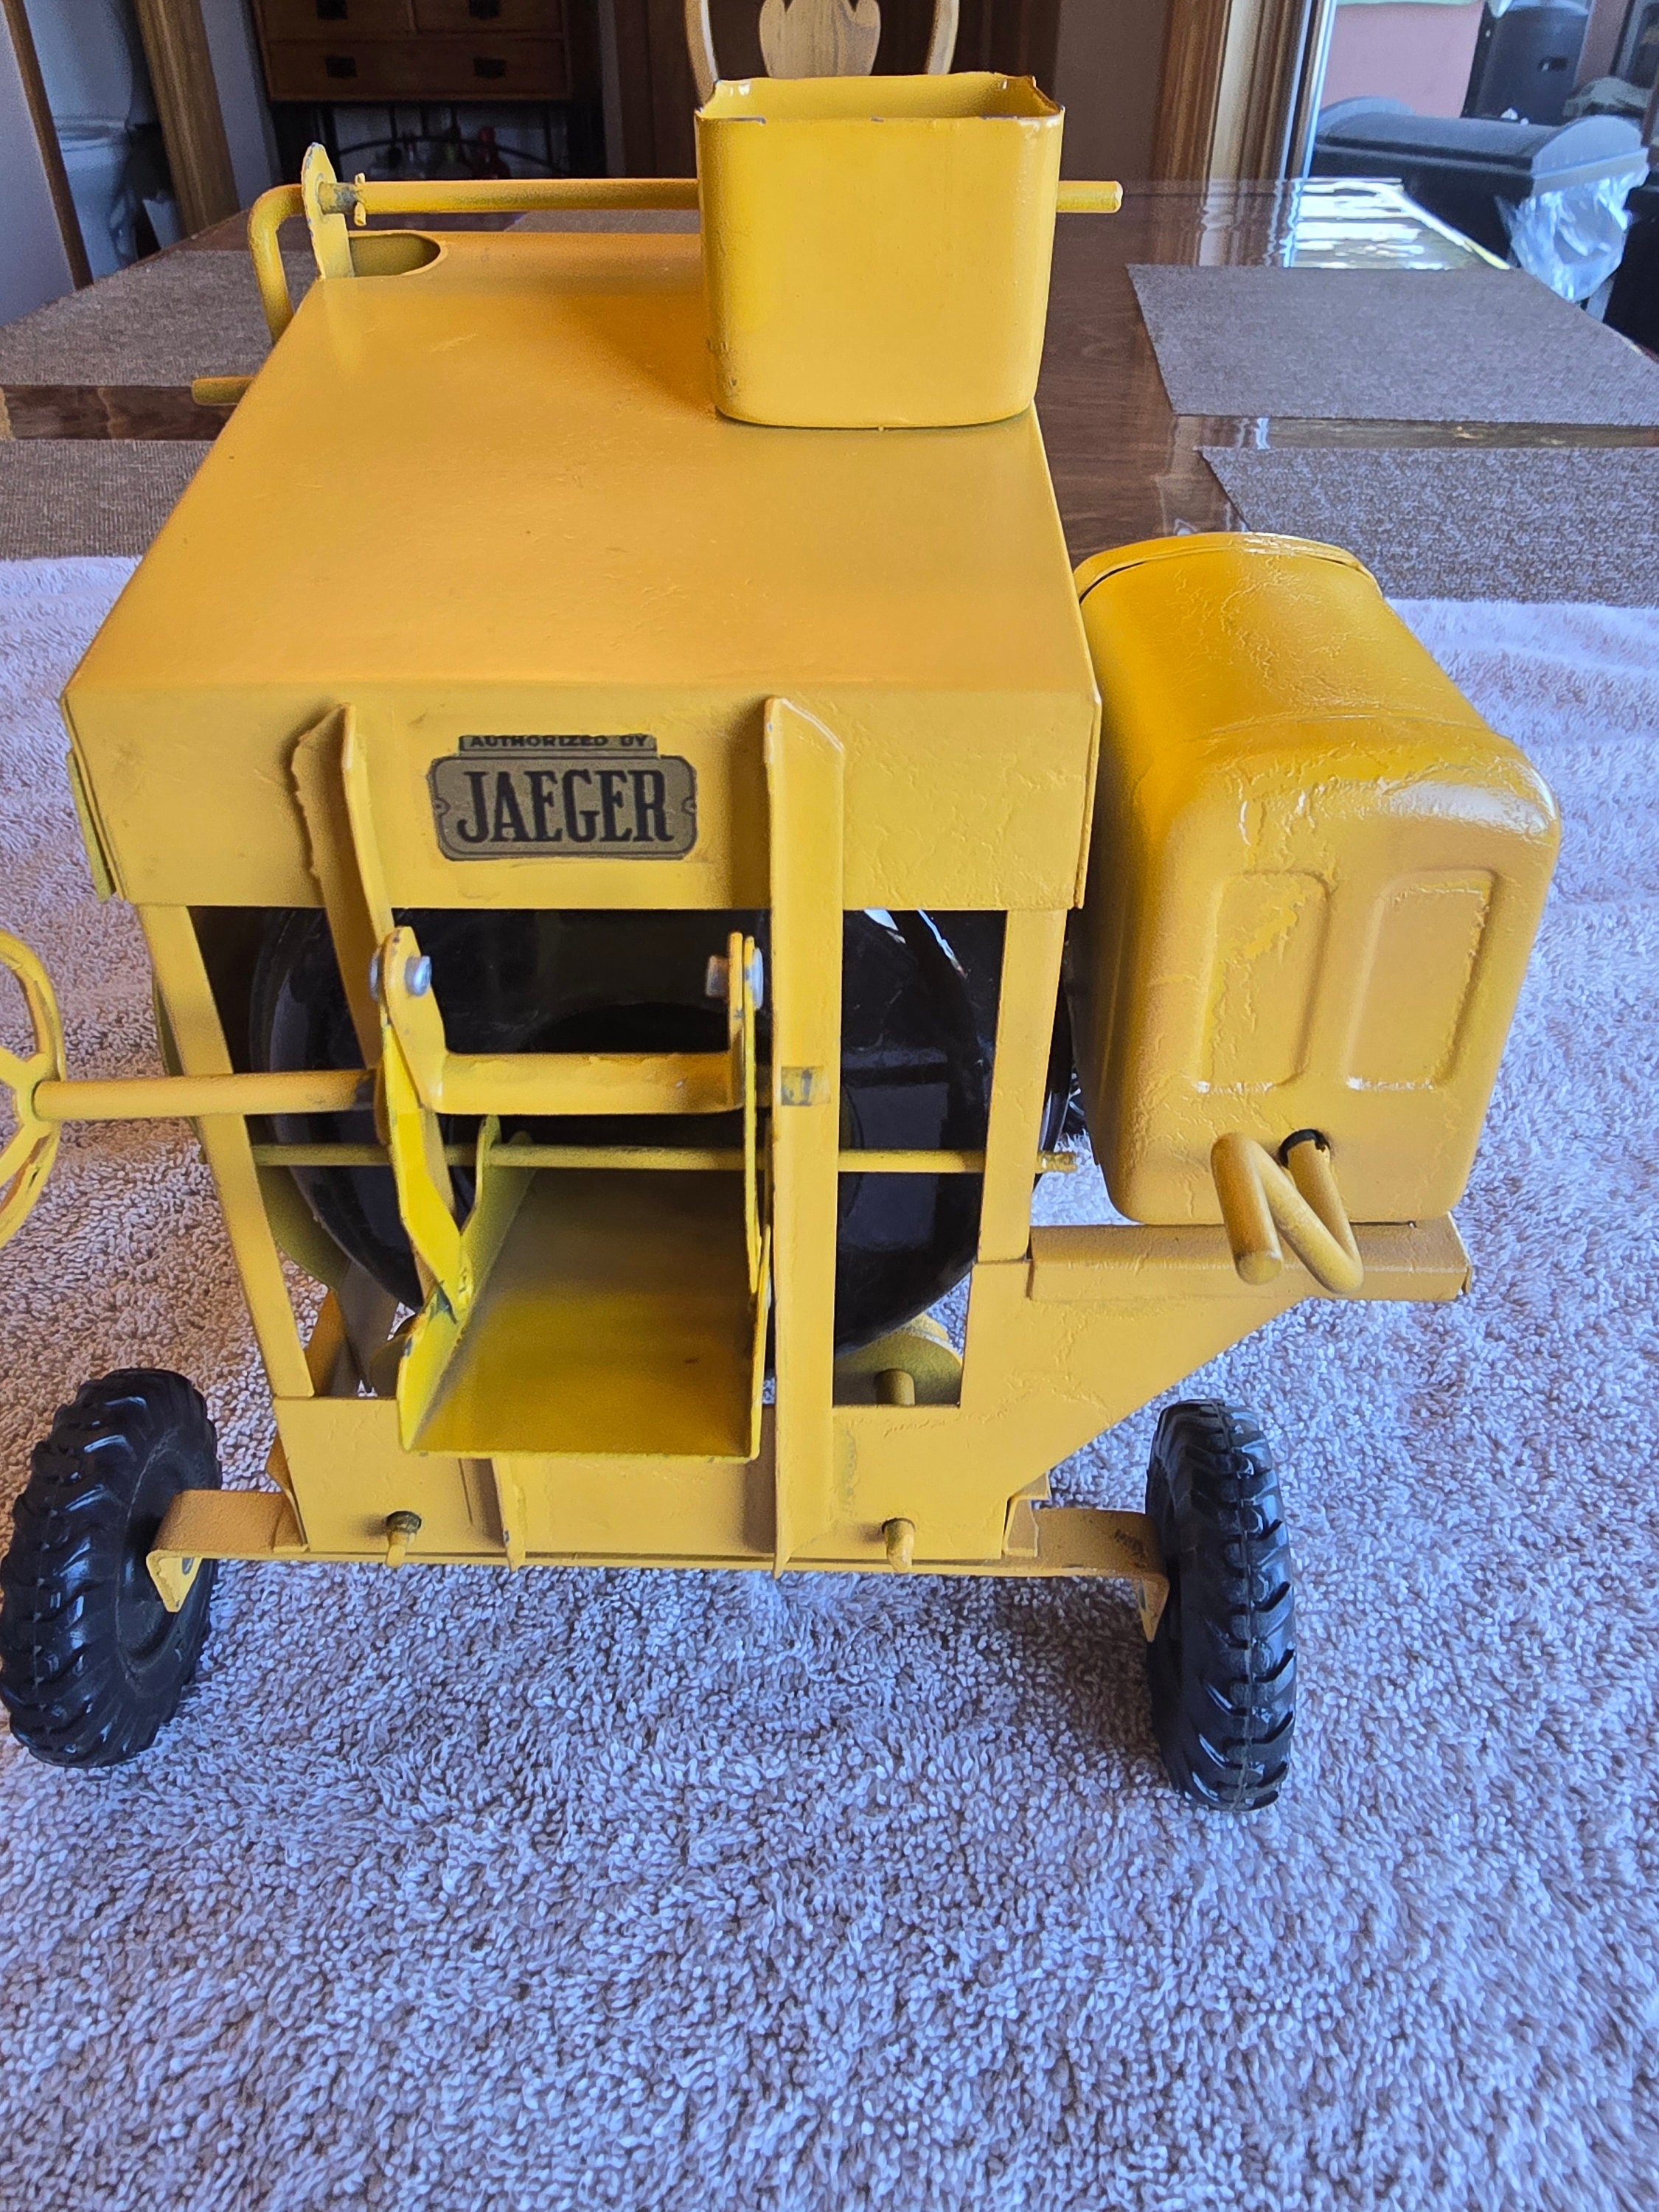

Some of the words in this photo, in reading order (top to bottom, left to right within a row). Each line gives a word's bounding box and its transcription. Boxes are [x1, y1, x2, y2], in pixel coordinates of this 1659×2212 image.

[470, 735, 608, 747] AUTHORIZED
[620, 735, 647, 746] BY
[457, 769, 675, 843] JAEGER
